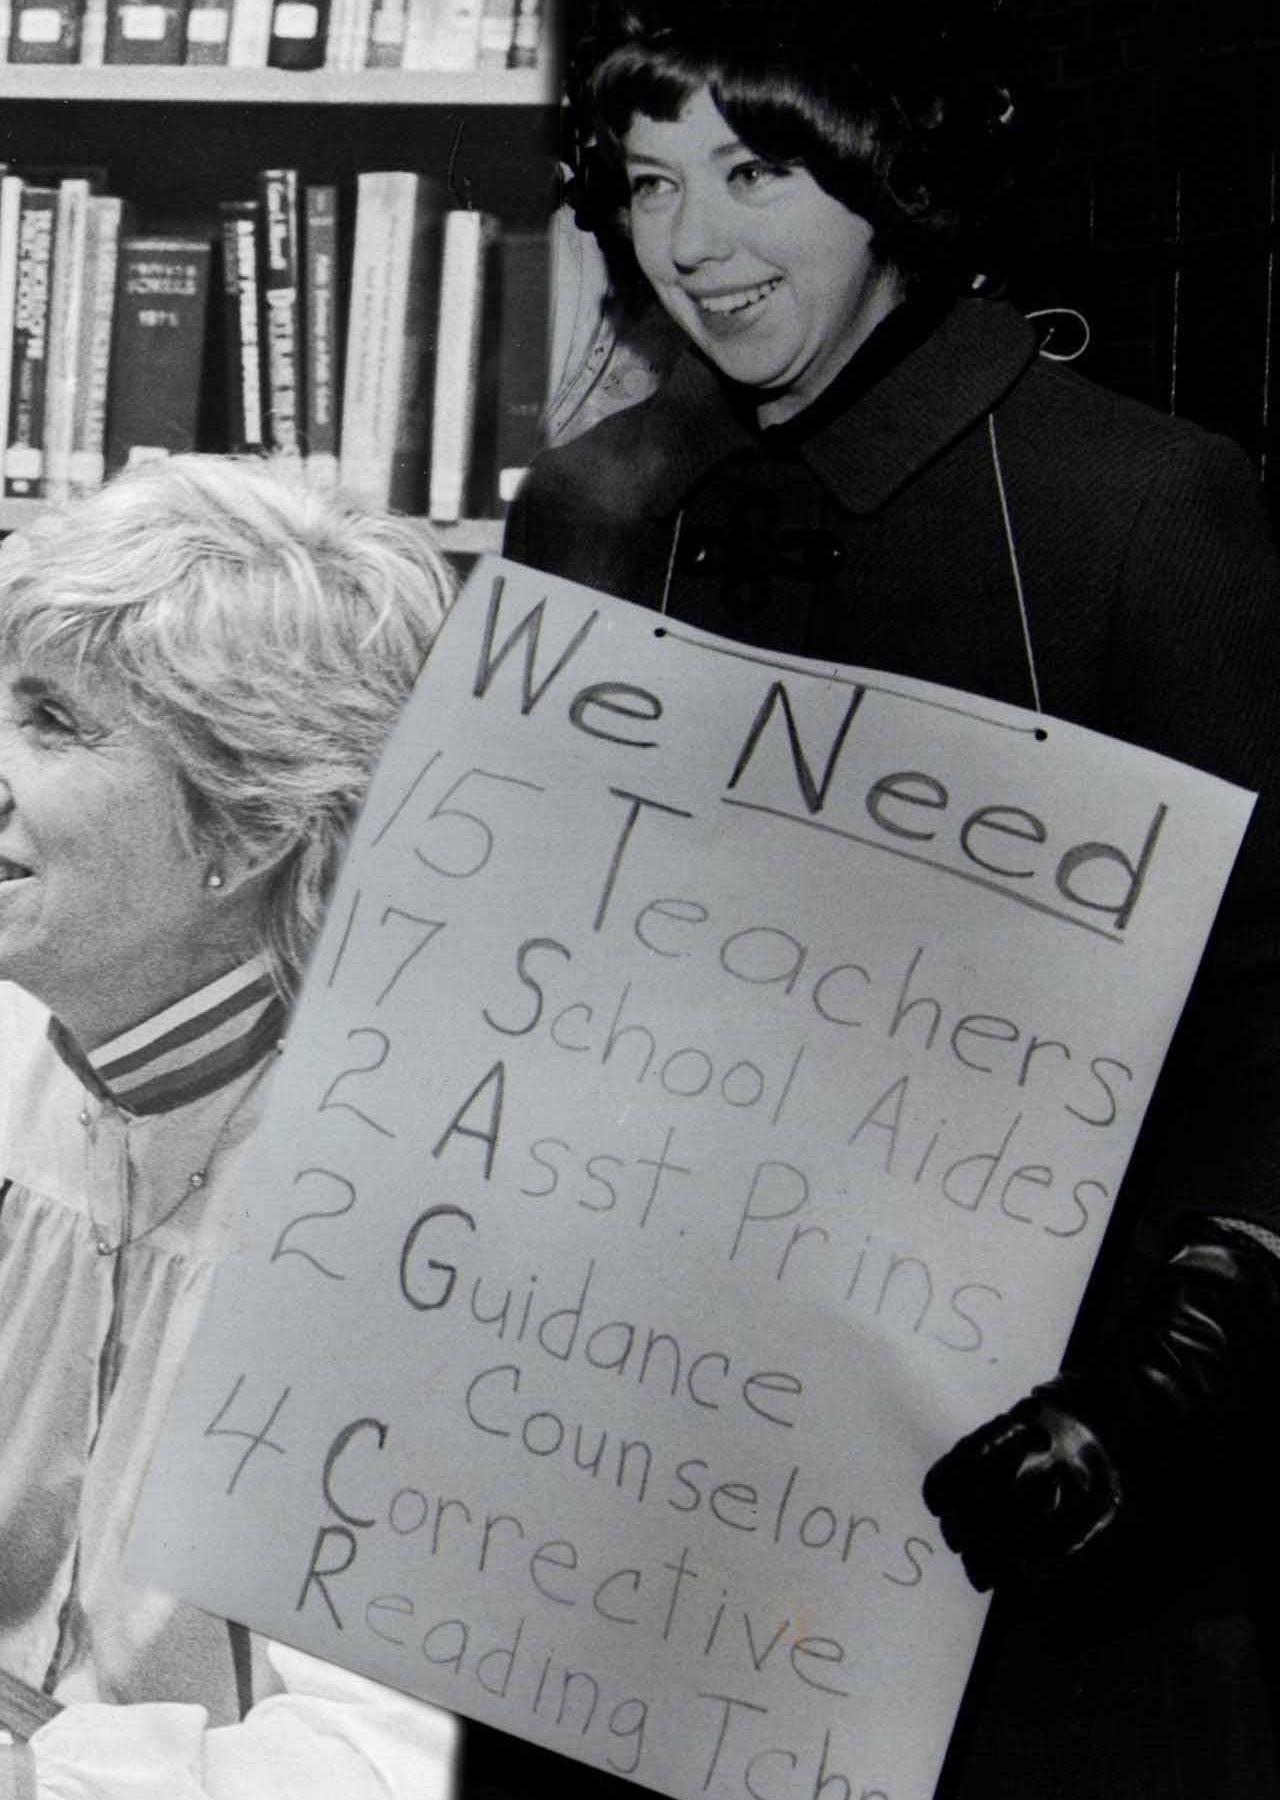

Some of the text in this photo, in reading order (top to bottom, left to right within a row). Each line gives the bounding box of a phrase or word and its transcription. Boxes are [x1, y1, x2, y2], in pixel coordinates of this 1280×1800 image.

[473, 575, 1168, 930] We Need
[328, 889, 1109, 1237] 17 School Aides
[371, 750, 1133, 1127] 15 Teachers
[270, 1167, 802, 1427] 2 Guidance
[318, 1026, 396, 1139] 2
[730, 1160, 999, 1365] Prins.
[204, 1374, 849, 1698] 4 Corrective
[466, 1365, 934, 1587] Counselors
[296, 1525, 648, 1774] Reading
